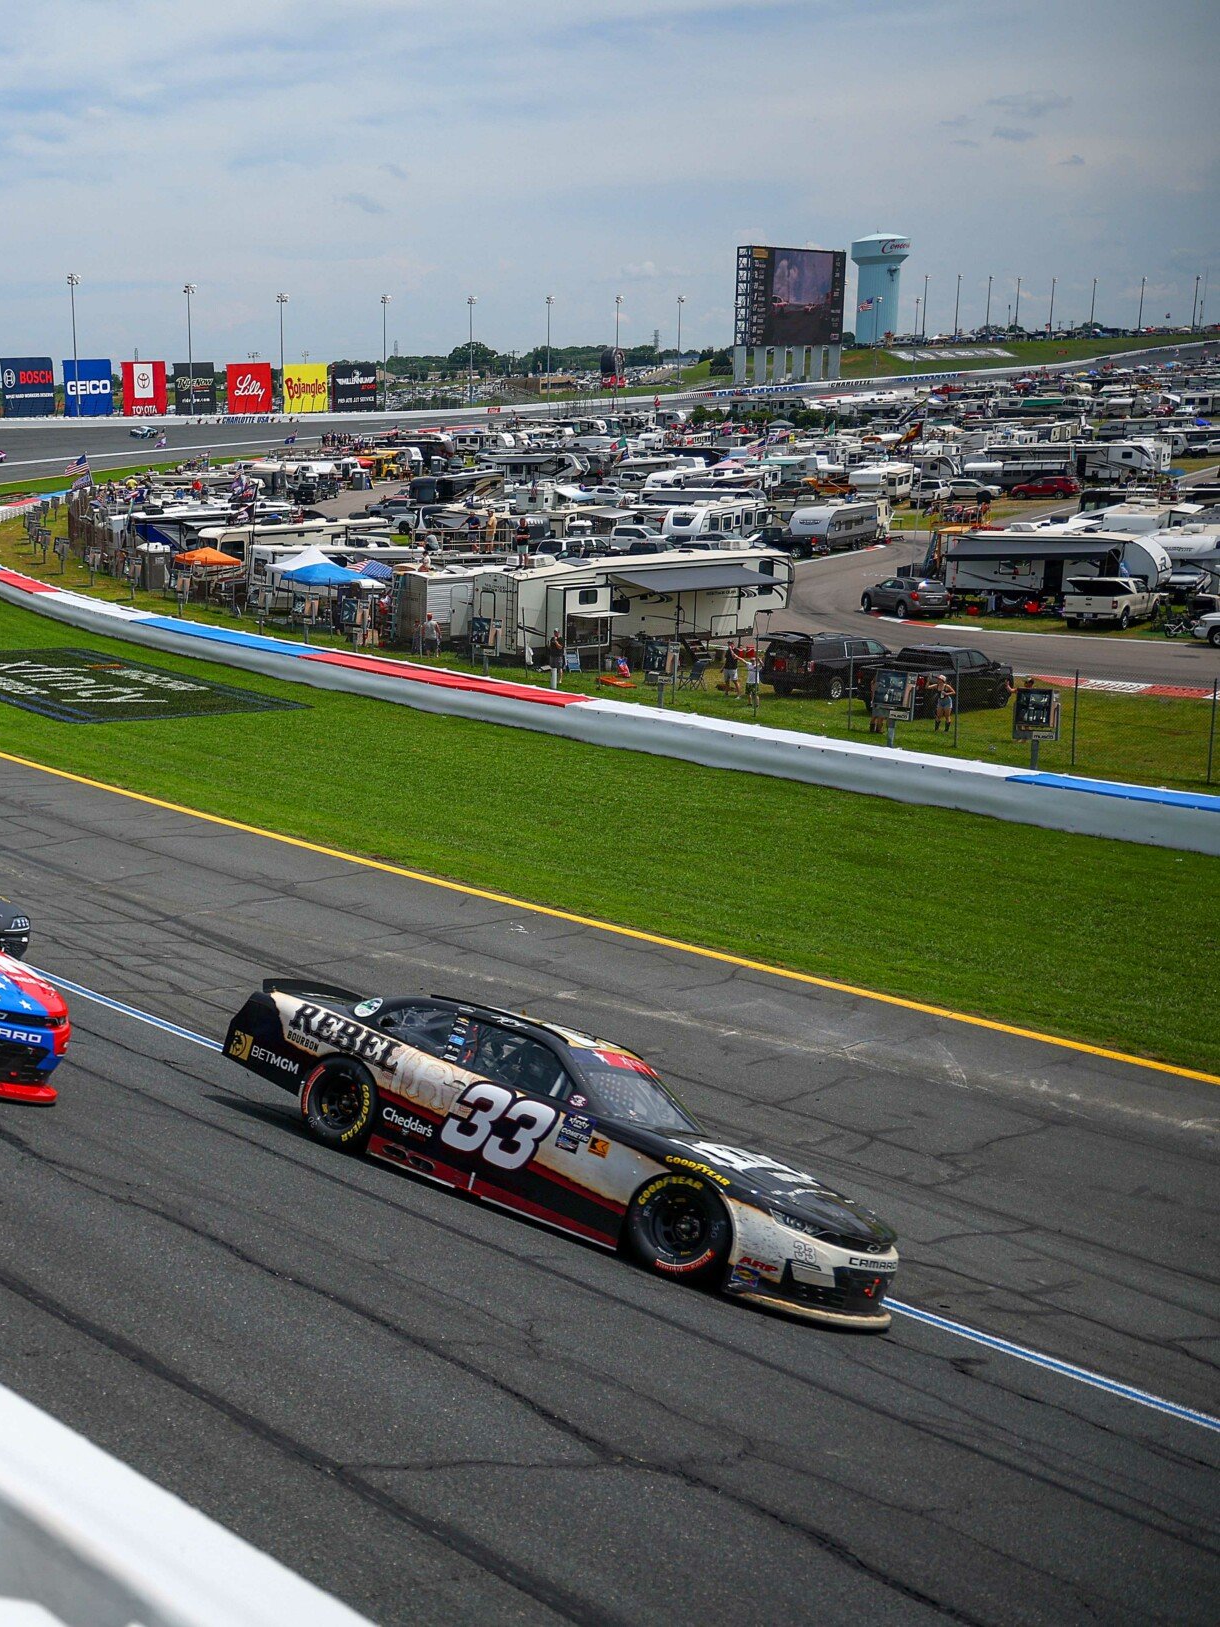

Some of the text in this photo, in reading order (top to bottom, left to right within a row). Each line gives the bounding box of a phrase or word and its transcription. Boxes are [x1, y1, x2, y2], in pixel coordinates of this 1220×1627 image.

[19, 371, 53, 384] BOSCH
[66, 380, 111, 395] GEICO
[234, 373, 266, 402] Lilly
[285, 377, 326, 400] Bojangles
[830, 380, 871, 388] CHARLOTTE
[132, 405, 158, 414] TOYOTA
[222, 416, 256, 424] CHARLOTTE
[286, 1030, 320, 1053] BOURBON
[289, 1003, 397, 1075] REBEL
[251, 1044, 300, 1075] BETMGM
[340, 1084, 371, 1143] GOODYEAR
[382, 1107, 434, 1138] Cheddar's
[568, 1116, 591, 1130] xfinity
[441, 1083, 557, 1170] 33
[561, 1127, 590, 1143] COMETIC
[664, 1155, 731, 1187] GOODYEAR
[637, 1175, 705, 1206] GOODYEAR
[738, 1256, 778, 1273] ARP
[793, 1241, 817, 1265] 33
